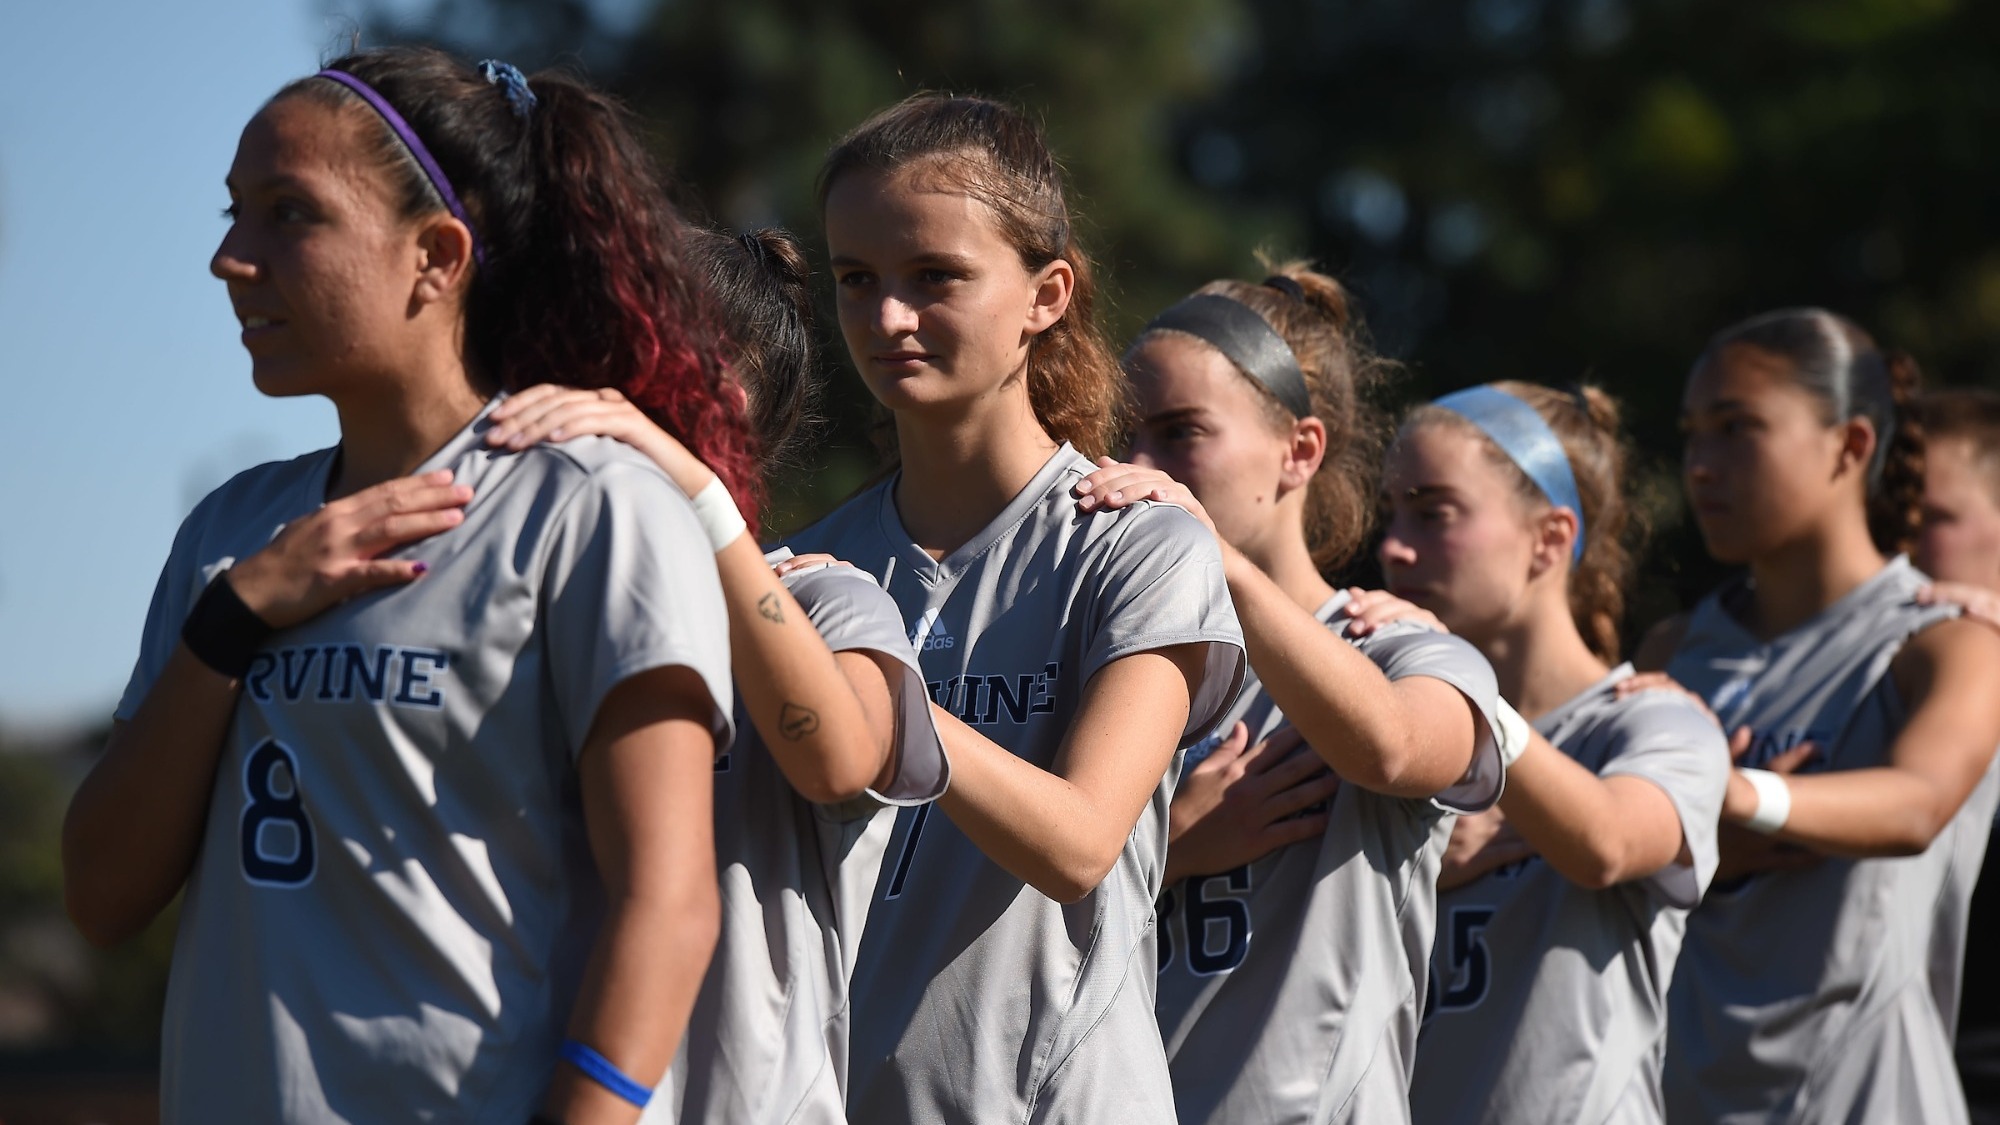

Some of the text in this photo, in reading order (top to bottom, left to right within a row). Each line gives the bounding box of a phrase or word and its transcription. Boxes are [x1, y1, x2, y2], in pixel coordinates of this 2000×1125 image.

[245, 642, 449, 709] RVINE
[910, 634, 954, 651] didas
[927, 661, 1059, 725] VINE
[238, 736, 318, 889] 8
[1423, 905, 1493, 1025] 5
